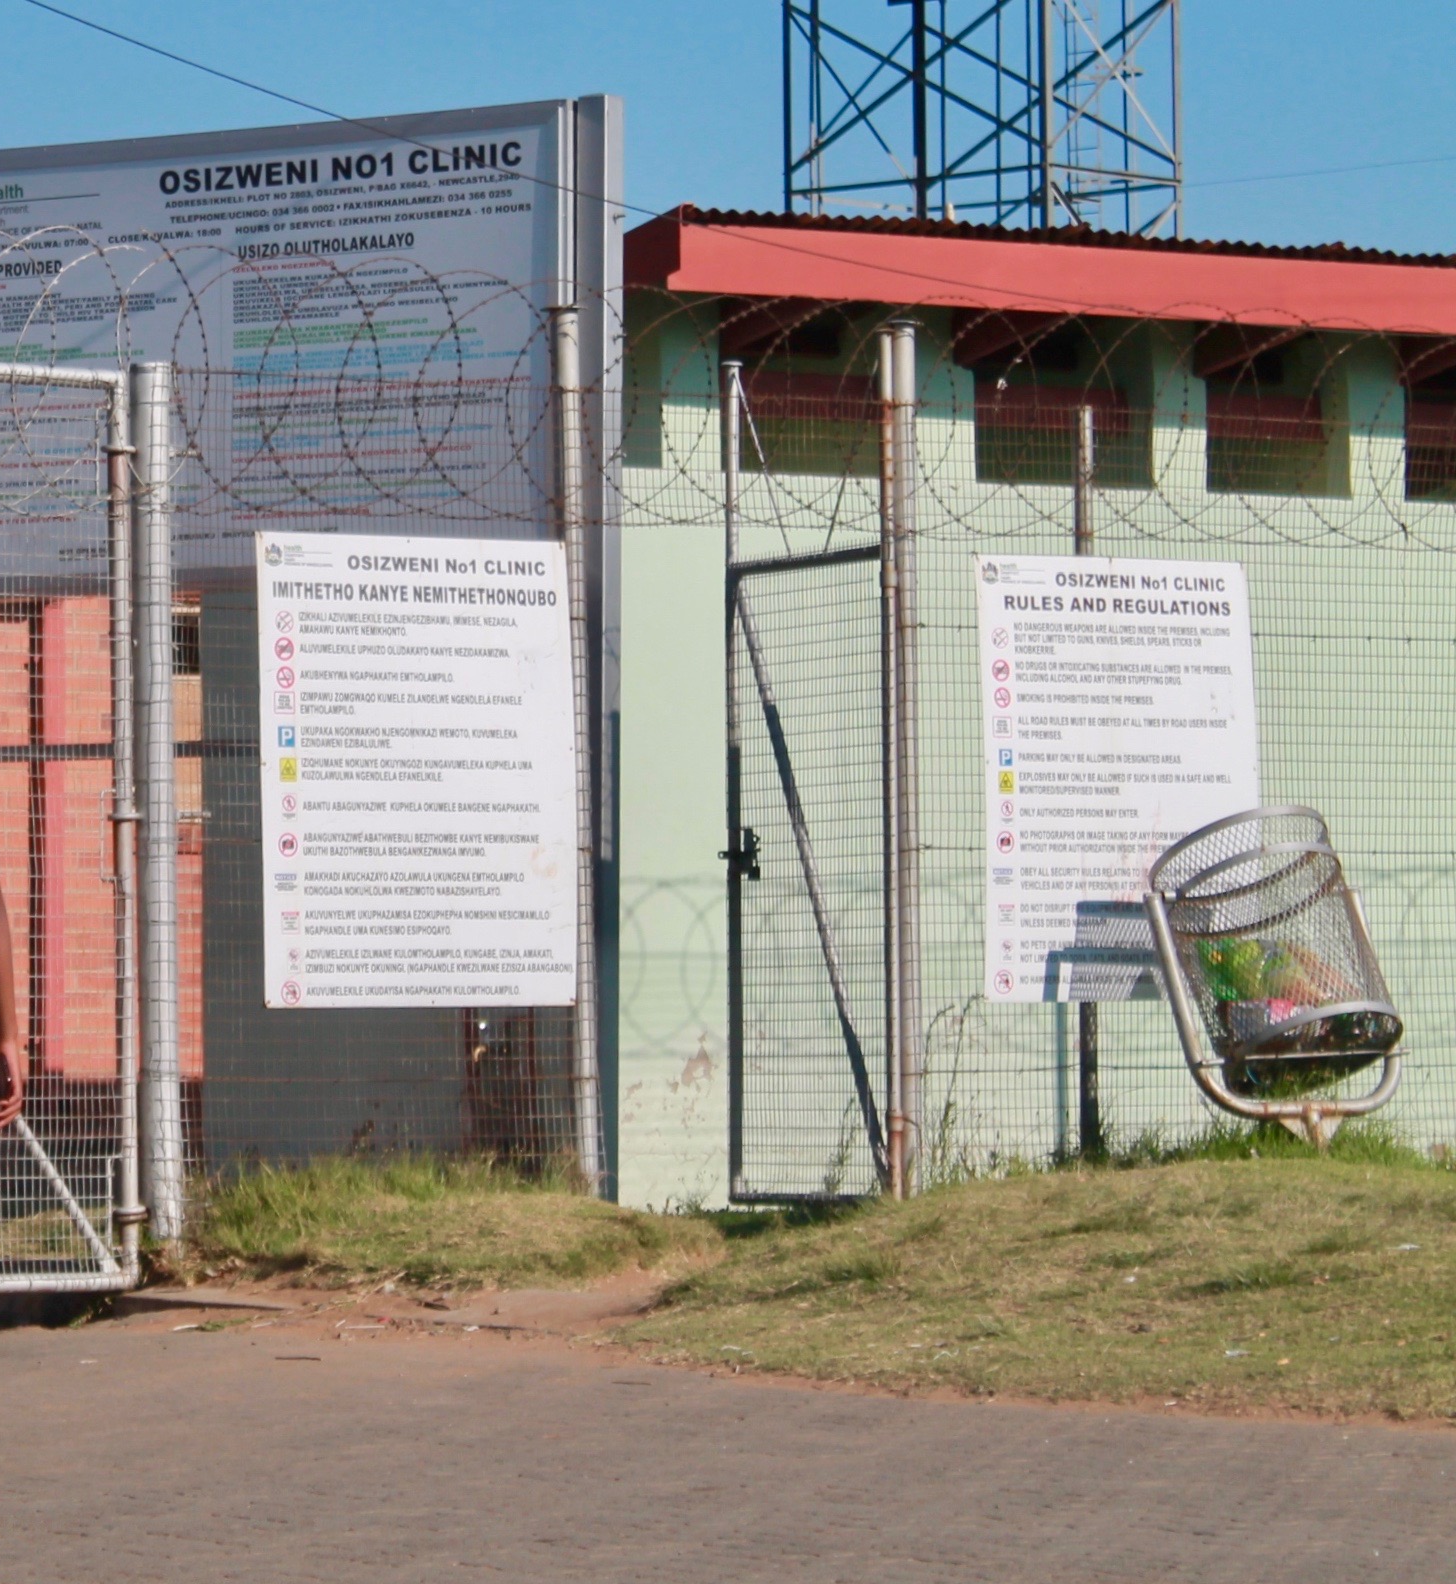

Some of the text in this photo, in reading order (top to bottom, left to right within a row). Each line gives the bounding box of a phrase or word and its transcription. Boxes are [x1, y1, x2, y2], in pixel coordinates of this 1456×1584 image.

[160, 141, 522, 194] OSIZWENI NO1 CLINIC
[165, 196, 244, 209] ADDRESS/IKHELI:
[247, 194, 270, 203] PLOT
[274, 192, 286, 200] NO
[316, 185, 366, 196] OSIZWENI,
[170, 210, 270, 224] TELEPHONE/UCINGO:
[272, 208, 288, 216] 034
[292, 206, 309, 215] 366
[312, 204, 334, 213] 0002
[448, 194, 465, 202] 034
[469, 192, 486, 200] 366
[489, 189, 512, 198] 0255
[235, 203, 531, 234] HOURS OF SERVICE: IZIKHATHI ZOKUSEBENZA 10 HOURS
[22, 227, 32, 235] OF
[64, 238, 88, 247] 07:00
[196, 228, 222, 237] 18:00
[238, 232, 414, 259] USIZO OLUTHOLAKALAYO
[347, 555, 438, 572] OSIZWENI
[445, 558, 476, 574] No1
[484, 559, 544, 576] CLINIC
[1055, 572, 1135, 589] OSIZWENI
[1141, 576, 1167, 590] No1
[1173, 576, 1224, 592] CLINIC
[272, 580, 556, 606] IMITHETHO KANYE NEMITHETHONQUBO
[1004, 594, 1230, 616] RULES AND REGULATIONS
[298, 611, 327, 622] IZIKHALI
[328, 612, 381, 623] AZIVUMELEKILE
[482, 616, 517, 627] NEZAGILA,
[299, 624, 334, 634] AMAHAWU
[335, 624, 359, 635] KANYE
[299, 643, 356, 654] ALUVUMELEKILE
[357, 644, 386, 655] UPHUZO
[386, 645, 429, 655] OLUDAKAYO
[429, 646, 452, 656] KANYE
[300, 670, 455, 682] AKUBHENYWA NGAPHAKATHI EMTHOLAMPILO.
[299, 691, 522, 705] IZIMPAWU ZOMGWAQO KUMELE ZILANDELWE NGENDLELA EFANELE
[1016, 693, 1045, 702] SMOKING
[1053, 693, 1089, 703] PROHIBITED
[1089, 694, 1110, 704] INSIDE
[1110, 694, 1122, 704] THE
[1123, 695, 1155, 705] PREMISES.
[299, 704, 357, 715] EMTHOLAMPILO.
[300, 725, 333, 736] UKUPAKA
[333, 726, 380, 736] NGOKWAKHO
[438, 728, 470, 738] WEMOTO,
[471, 728, 517, 739] KUVUMELEKA
[300, 737, 393, 749] EZINDAWENI EZIBALULIWE.
[344, 758, 378, 768] NOKUNYE
[379, 758, 422, 769] OKUYINGOZI
[484, 760, 516, 770] KUPHELA
[517, 760, 532, 770] UMA
[1018, 752, 1045, 762] PARKING
[1046, 753, 1058, 762] MAY
[1059, 753, 1076, 763] ONLY
[1086, 753, 1115, 763] ALLOWED
[1122, 754, 1160, 764] DESIGNATED
[1160, 754, 1183, 764] AREAS.
[301, 770, 445, 782] KUZOLAWULWA NGENDLELA EFANELIKILE.
[302, 800, 541, 812] ABANTU ABAGUNYAZIWE KUPHELA OKUMELE BANGENE NGAPHAKATHI.
[1019, 807, 1140, 818] ONLY AUTHORIZED PERSONS MAY ENTER.
[363, 832, 413, 843] ABATHWEBULI
[414, 833, 457, 843] BEZITHOMBE
[459, 833, 482, 843] KANYE
[302, 845, 328, 856] UKUTHI
[329, 845, 386, 856] BAZOTHWEBULA
[341, 871, 388, 881] AKUCHAZAYO
[389, 871, 432, 881] AZOLAWULA
[432, 871, 471, 881] UKUNGENA
[471, 872, 524, 882] EMTHOLAMPILO
[304, 909, 356, 920] AKUVUNYELWE
[357, 909, 411, 919] UKUPHAZAMISA
[412, 909, 463, 919] EZOKUPHEPHA
[463, 910, 497, 919] NOMSHINI
[304, 925, 452, 935] NGAPHANDLE UMA KUNESIMO ESIPHOQAYO.
[304, 948, 359, 959] AZIVUMELEKILE
[393, 948, 462, 958] KULOMTHOLAMPILO,
[462, 948, 498, 958] KUNGABE,
[498, 948, 522, 958] IZINJA,
[522, 948, 552, 958] AMAKATI,
[306, 985, 521, 996] AKUVUMELEKILE UKUDAYISA NGAPHAKATHI KULOMTHOLAMPILO.
